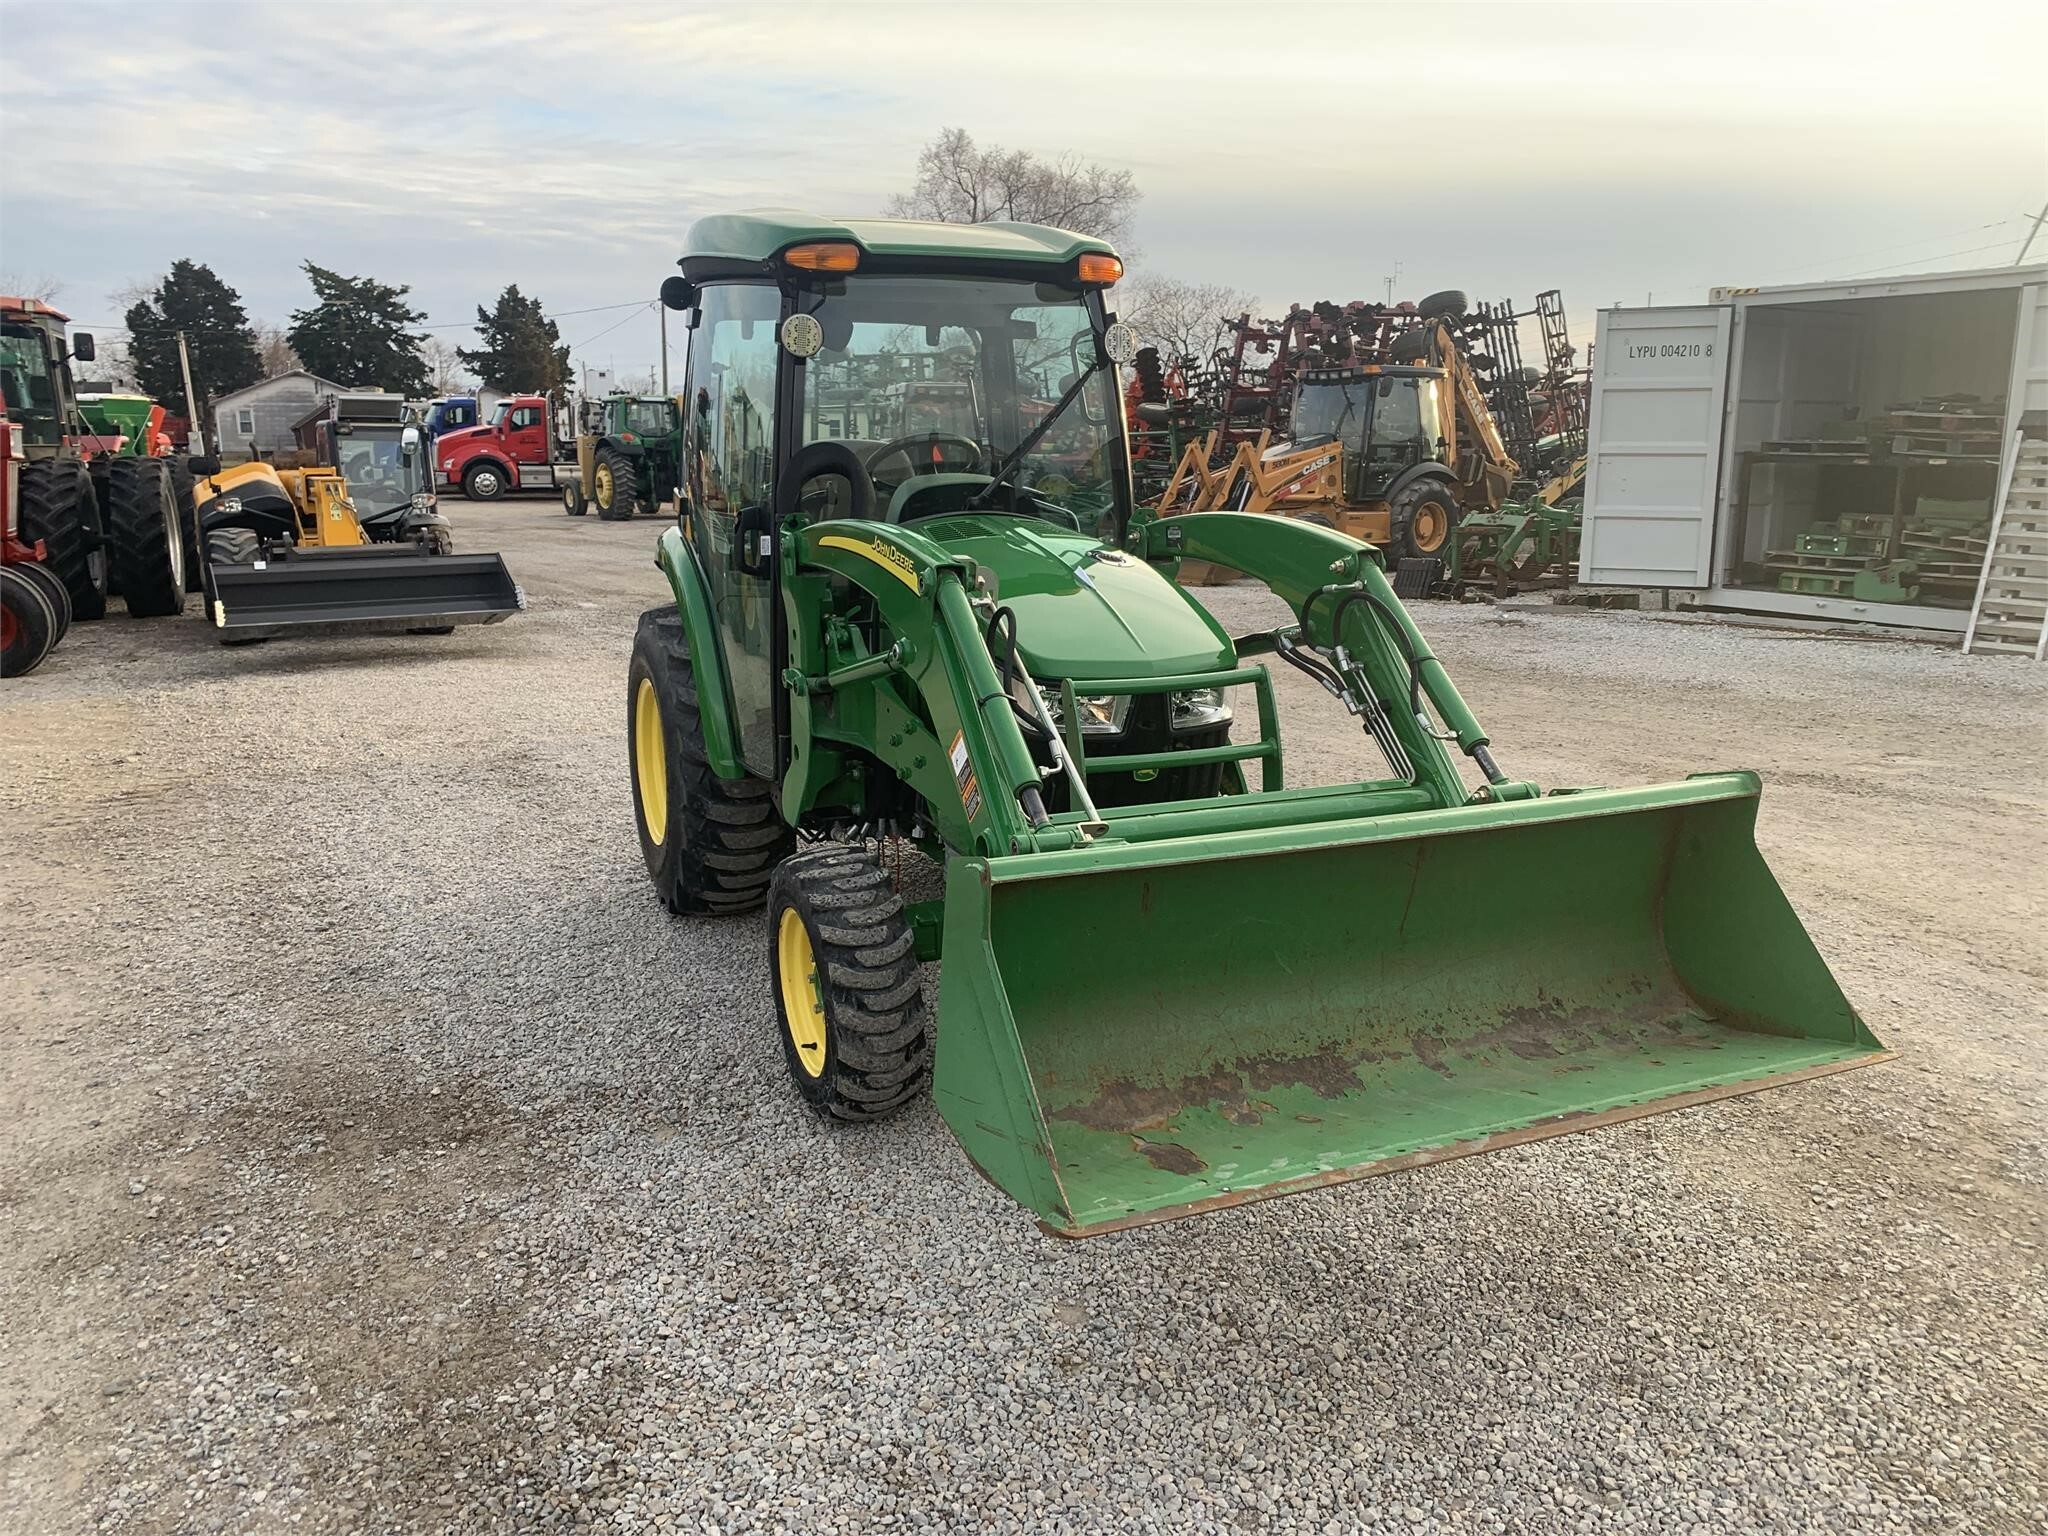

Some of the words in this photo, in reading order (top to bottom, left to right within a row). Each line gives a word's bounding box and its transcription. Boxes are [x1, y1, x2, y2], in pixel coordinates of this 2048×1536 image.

[1629, 346, 1657, 358] LYPU
[1660, 344, 1700, 357] 004210
[1705, 344, 1713, 357] 8
[1303, 456, 1330, 475] CASE
[871, 535, 891, 558] JOHN
[890, 545, 914, 574] DEERE
